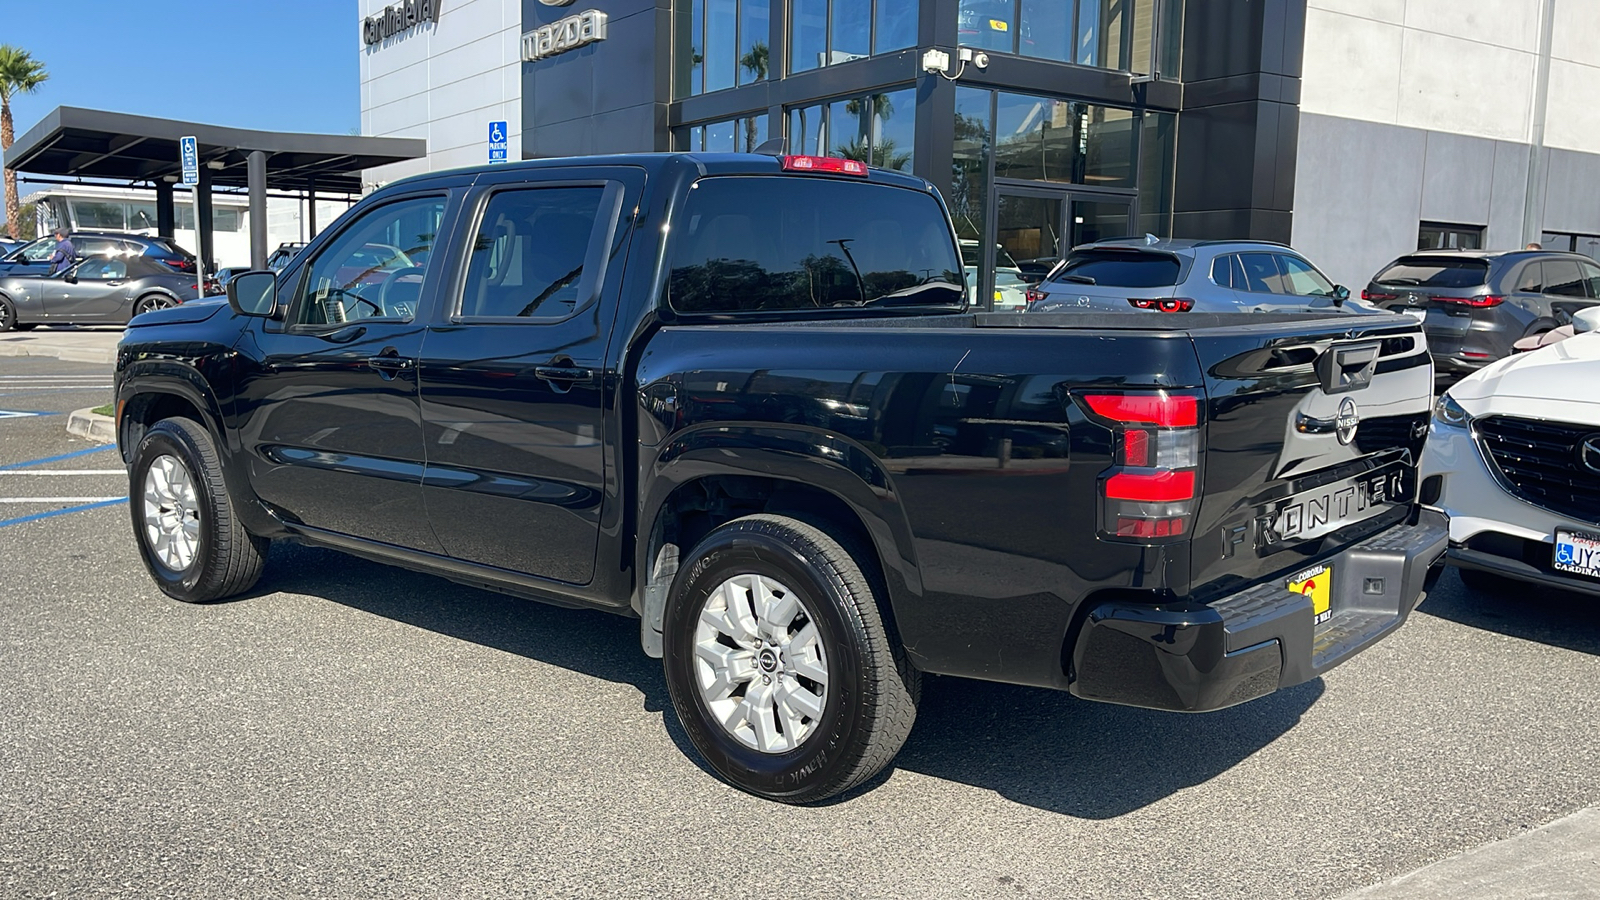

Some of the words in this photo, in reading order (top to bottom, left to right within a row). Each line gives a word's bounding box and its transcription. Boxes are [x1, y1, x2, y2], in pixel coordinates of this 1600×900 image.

[1221, 469, 1403, 560] FRONTIER
[1298, 565, 1323, 582] CORONA
[1554, 562, 1600, 578] CARDINA
